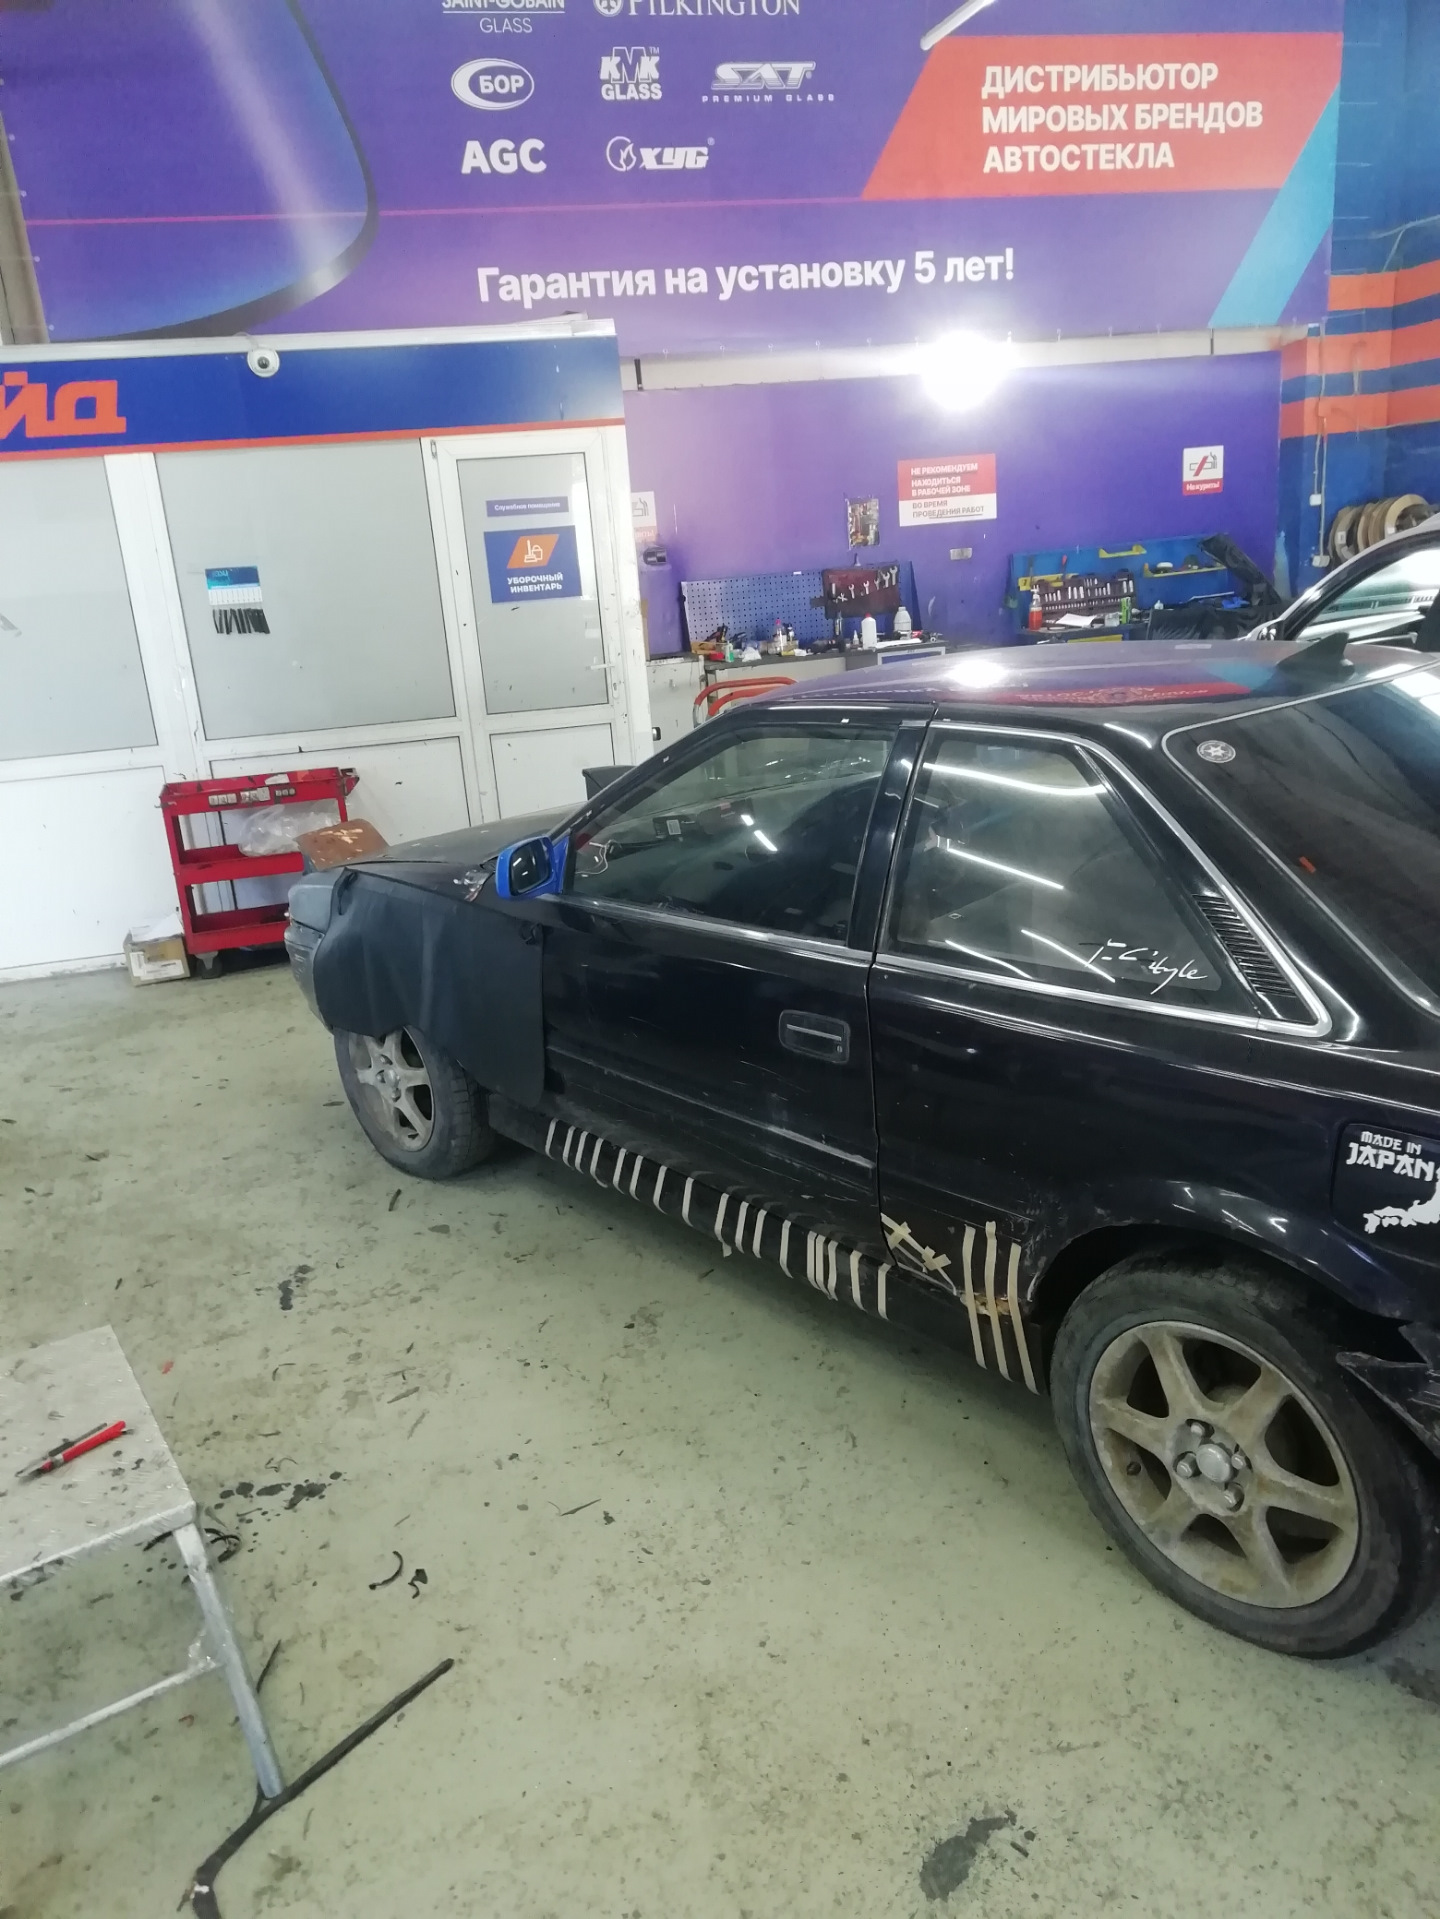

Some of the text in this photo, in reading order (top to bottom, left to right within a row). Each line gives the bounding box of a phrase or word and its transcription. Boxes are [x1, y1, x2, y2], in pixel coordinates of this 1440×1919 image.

[479, 17, 533, 33] GLASS
[480, 75, 525, 94] БОР
[711, 61, 816, 90] SAT
[981, 63, 1218, 99] ДИСТРИБЬЮТОР
[601, 83, 662, 100] GLASS
[982, 101, 1263, 133] МИРОВЫХ БРЕНДОВ
[461, 139, 547, 174] AGC
[639, 146, 709, 170] XYG
[983, 143, 1174, 173] АВТОСТЕКЛА
[477, 248, 1015, 309] Гарантия на установку 5 лет!
[910, 463, 978, 476] НЕ РЕКОМЕНДУЕМ
[911, 476, 961, 487] НАХОДИТЬСЯ
[911, 485, 971, 497] В РАБОЧЕЙ ЗОНЕ
[912, 505, 985, 519] ПРОВЕДЕНИЯ РАБОТ
[923, 500, 948, 508] ВРЕМЯ
[507, 573, 563, 584] УБОРОЧНЫЙ
[510, 583, 563, 594] ИНВЕНТАРЬ
[1360, 1131, 1422, 1155] MADE IN
[1346, 1142, 1435, 1182] JAPAN
